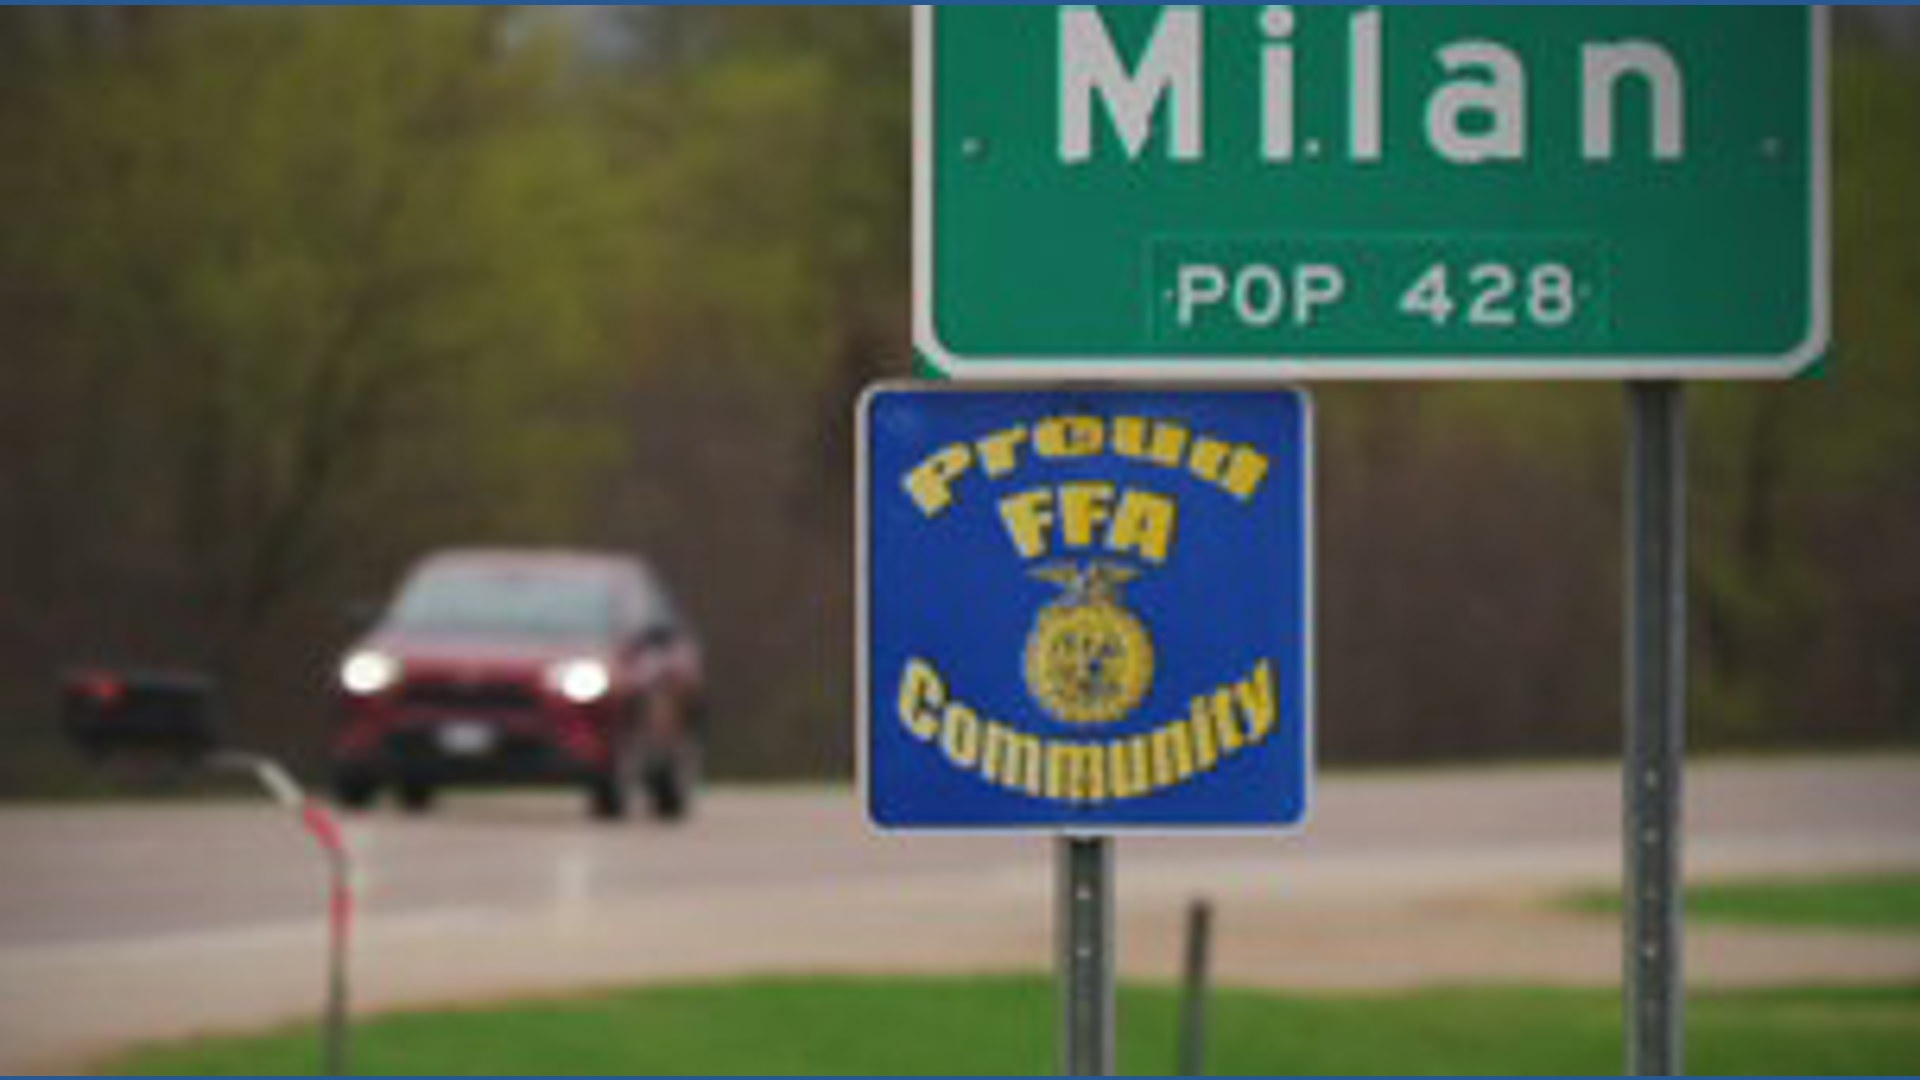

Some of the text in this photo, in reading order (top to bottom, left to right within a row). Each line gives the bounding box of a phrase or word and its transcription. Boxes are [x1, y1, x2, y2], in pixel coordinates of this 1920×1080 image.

[1057, 5, 1685, 163] Milan
[1175, 263, 1576, 327] POP 428
[902, 415, 1269, 518] Proud
[999, 481, 1176, 562] FFA
[898, 656, 1277, 800] Community
